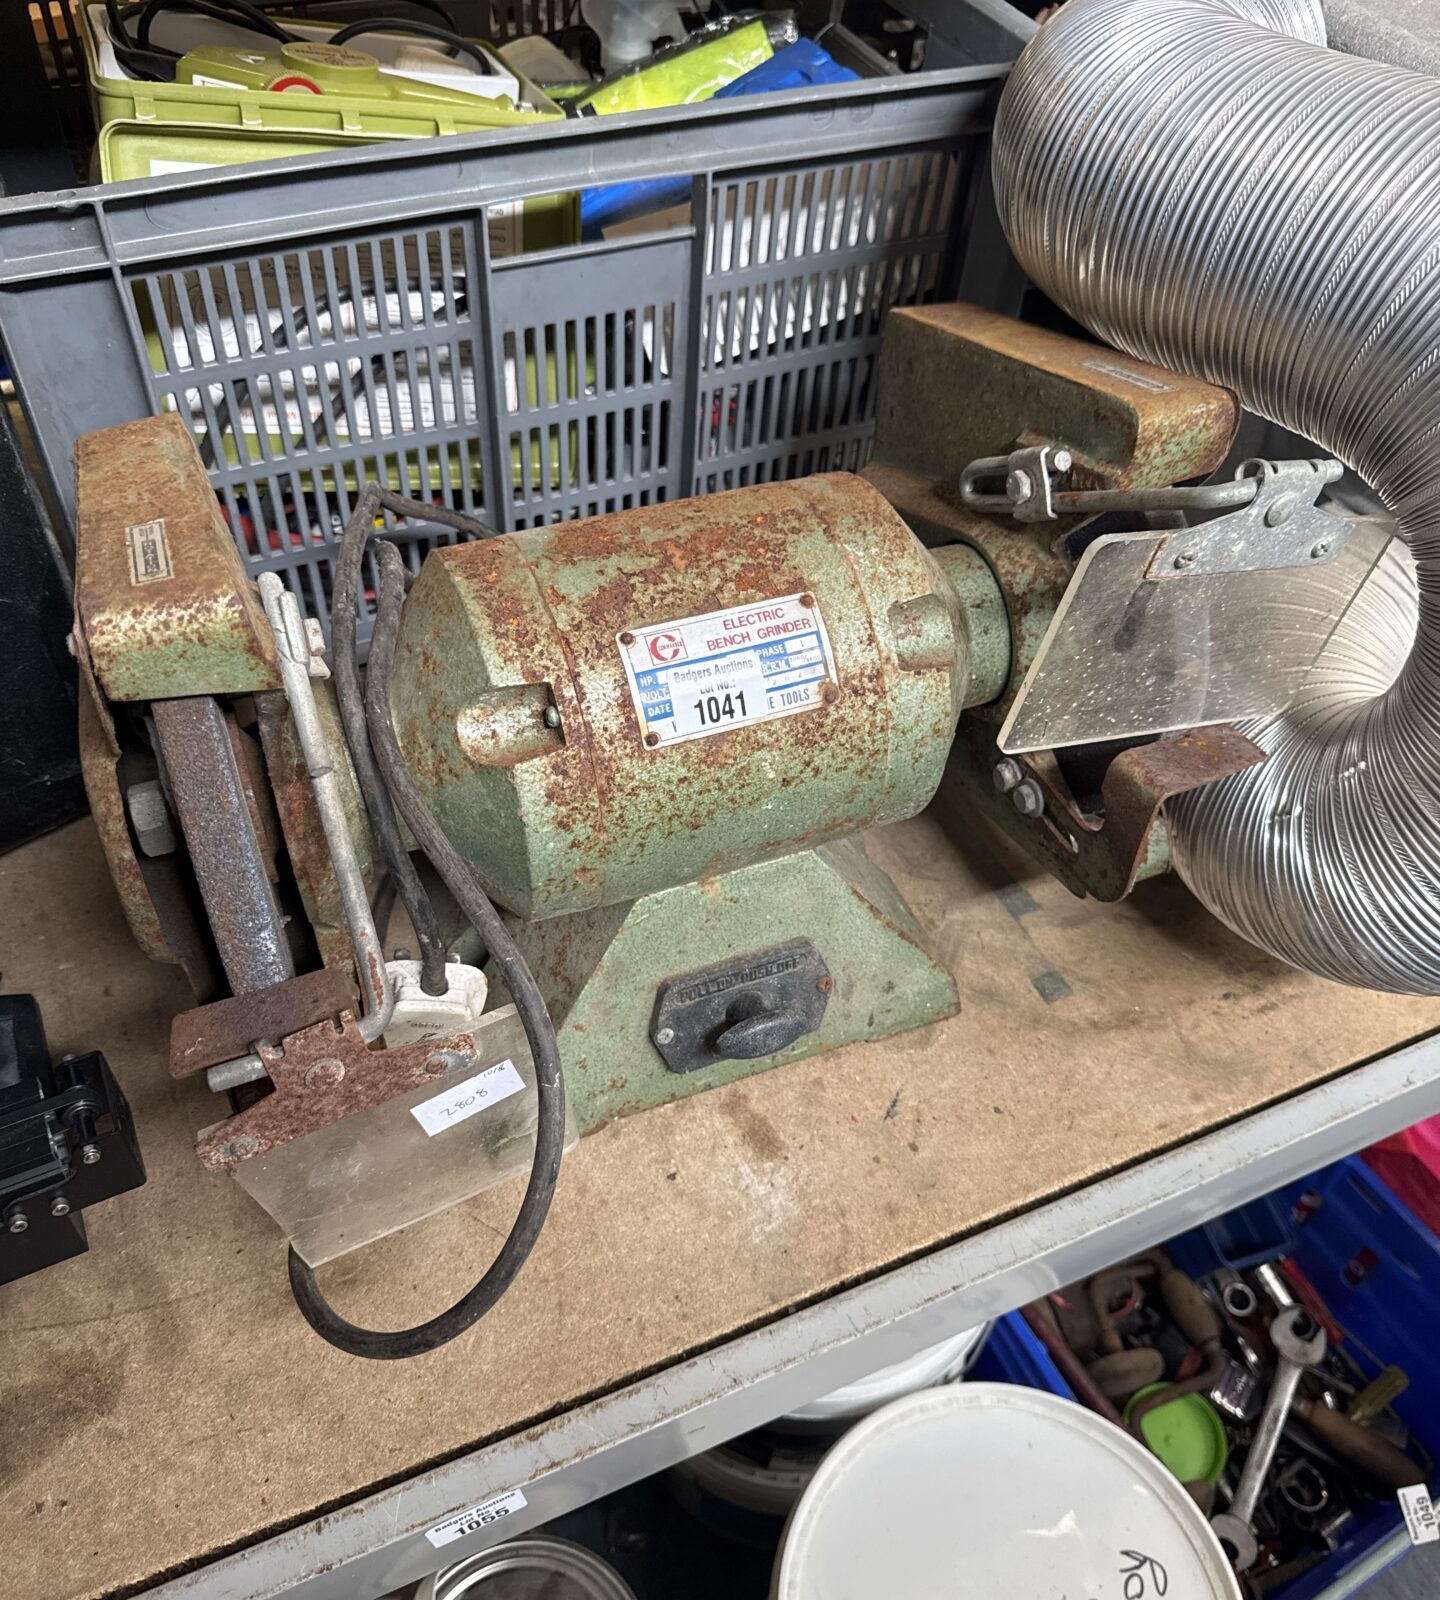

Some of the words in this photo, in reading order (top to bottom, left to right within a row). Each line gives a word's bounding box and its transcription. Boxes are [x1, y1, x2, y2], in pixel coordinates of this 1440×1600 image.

[723, 607, 785, 631] ELECTRIC
[706, 631, 751, 652] BENCH
[757, 618, 812, 640] GRINDER
[758, 644, 785, 657] PHASE
[674, 666, 712, 683] Badgers
[714, 658, 753, 676] Auctions
[648, 703, 672, 717] DATE
[693, 690, 746, 726] 1041
[780, 688, 810, 706] TOOLS
[435, 1513, 473, 1533] Badgers
[476, 1492, 516, 1513] Auctions
[454, 1506, 510, 1536] 1055
[1416, 1496, 1436, 1531] 1049
